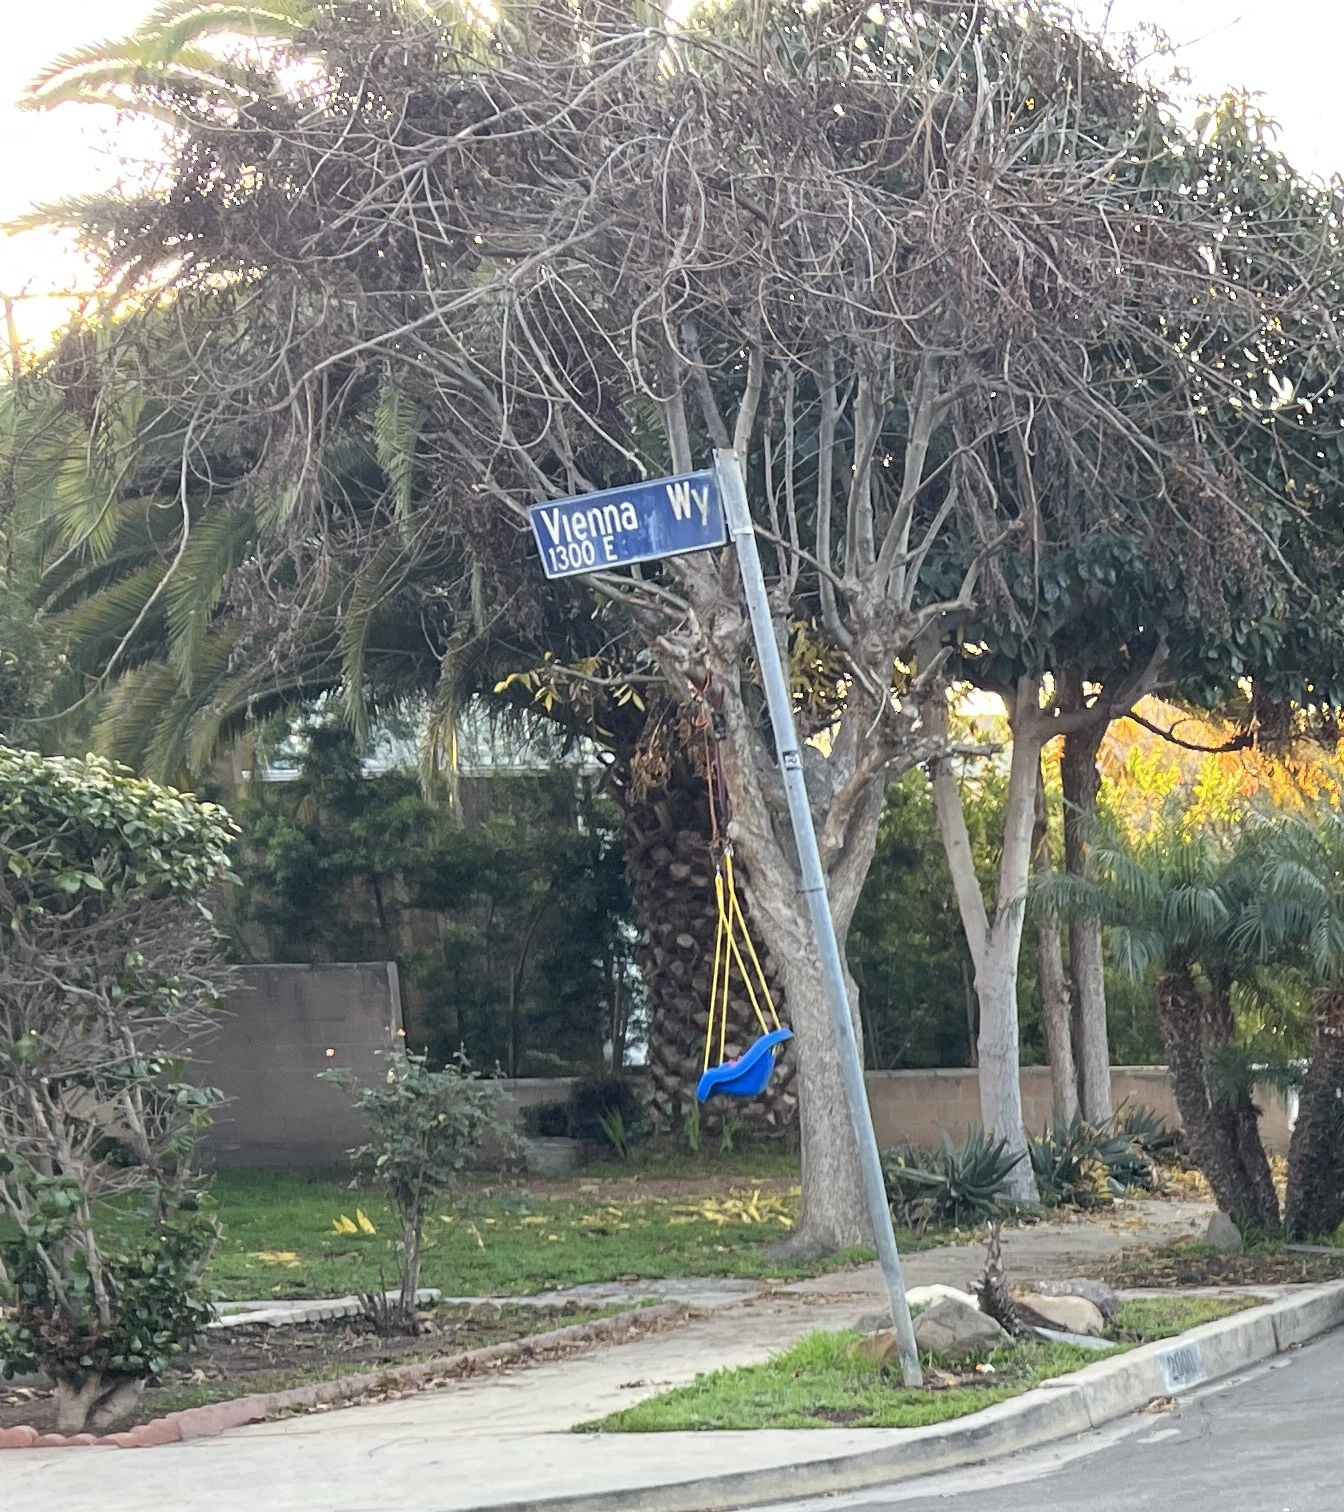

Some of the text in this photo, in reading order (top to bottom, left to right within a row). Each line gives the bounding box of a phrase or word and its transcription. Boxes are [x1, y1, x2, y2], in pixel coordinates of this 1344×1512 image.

[540, 480, 709, 545] Vienna Wy
[549, 535, 618, 572] 1300 E
